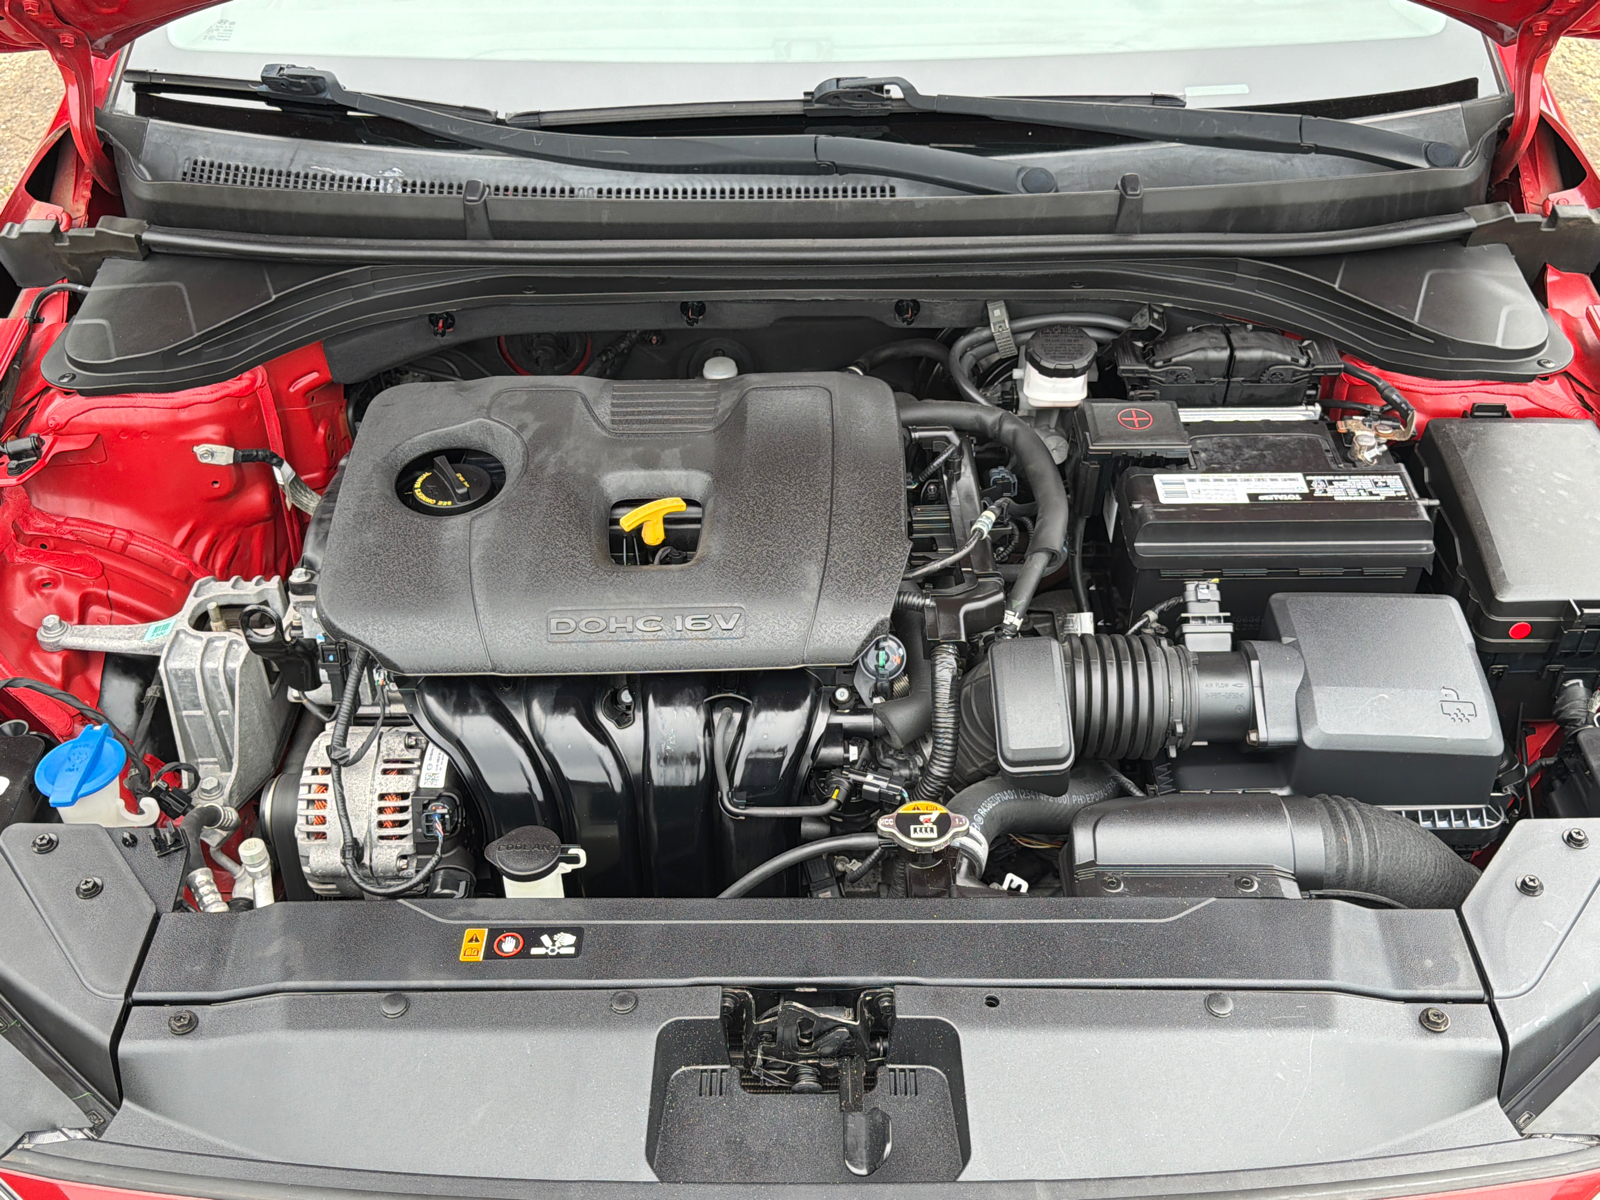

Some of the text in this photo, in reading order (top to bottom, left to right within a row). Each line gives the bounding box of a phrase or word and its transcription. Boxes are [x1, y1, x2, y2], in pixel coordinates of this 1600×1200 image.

[549, 613, 742, 635] DOHC 16V
[955, 817, 966, 825] 1.1
[497, 841, 560, 853] COOLANT
